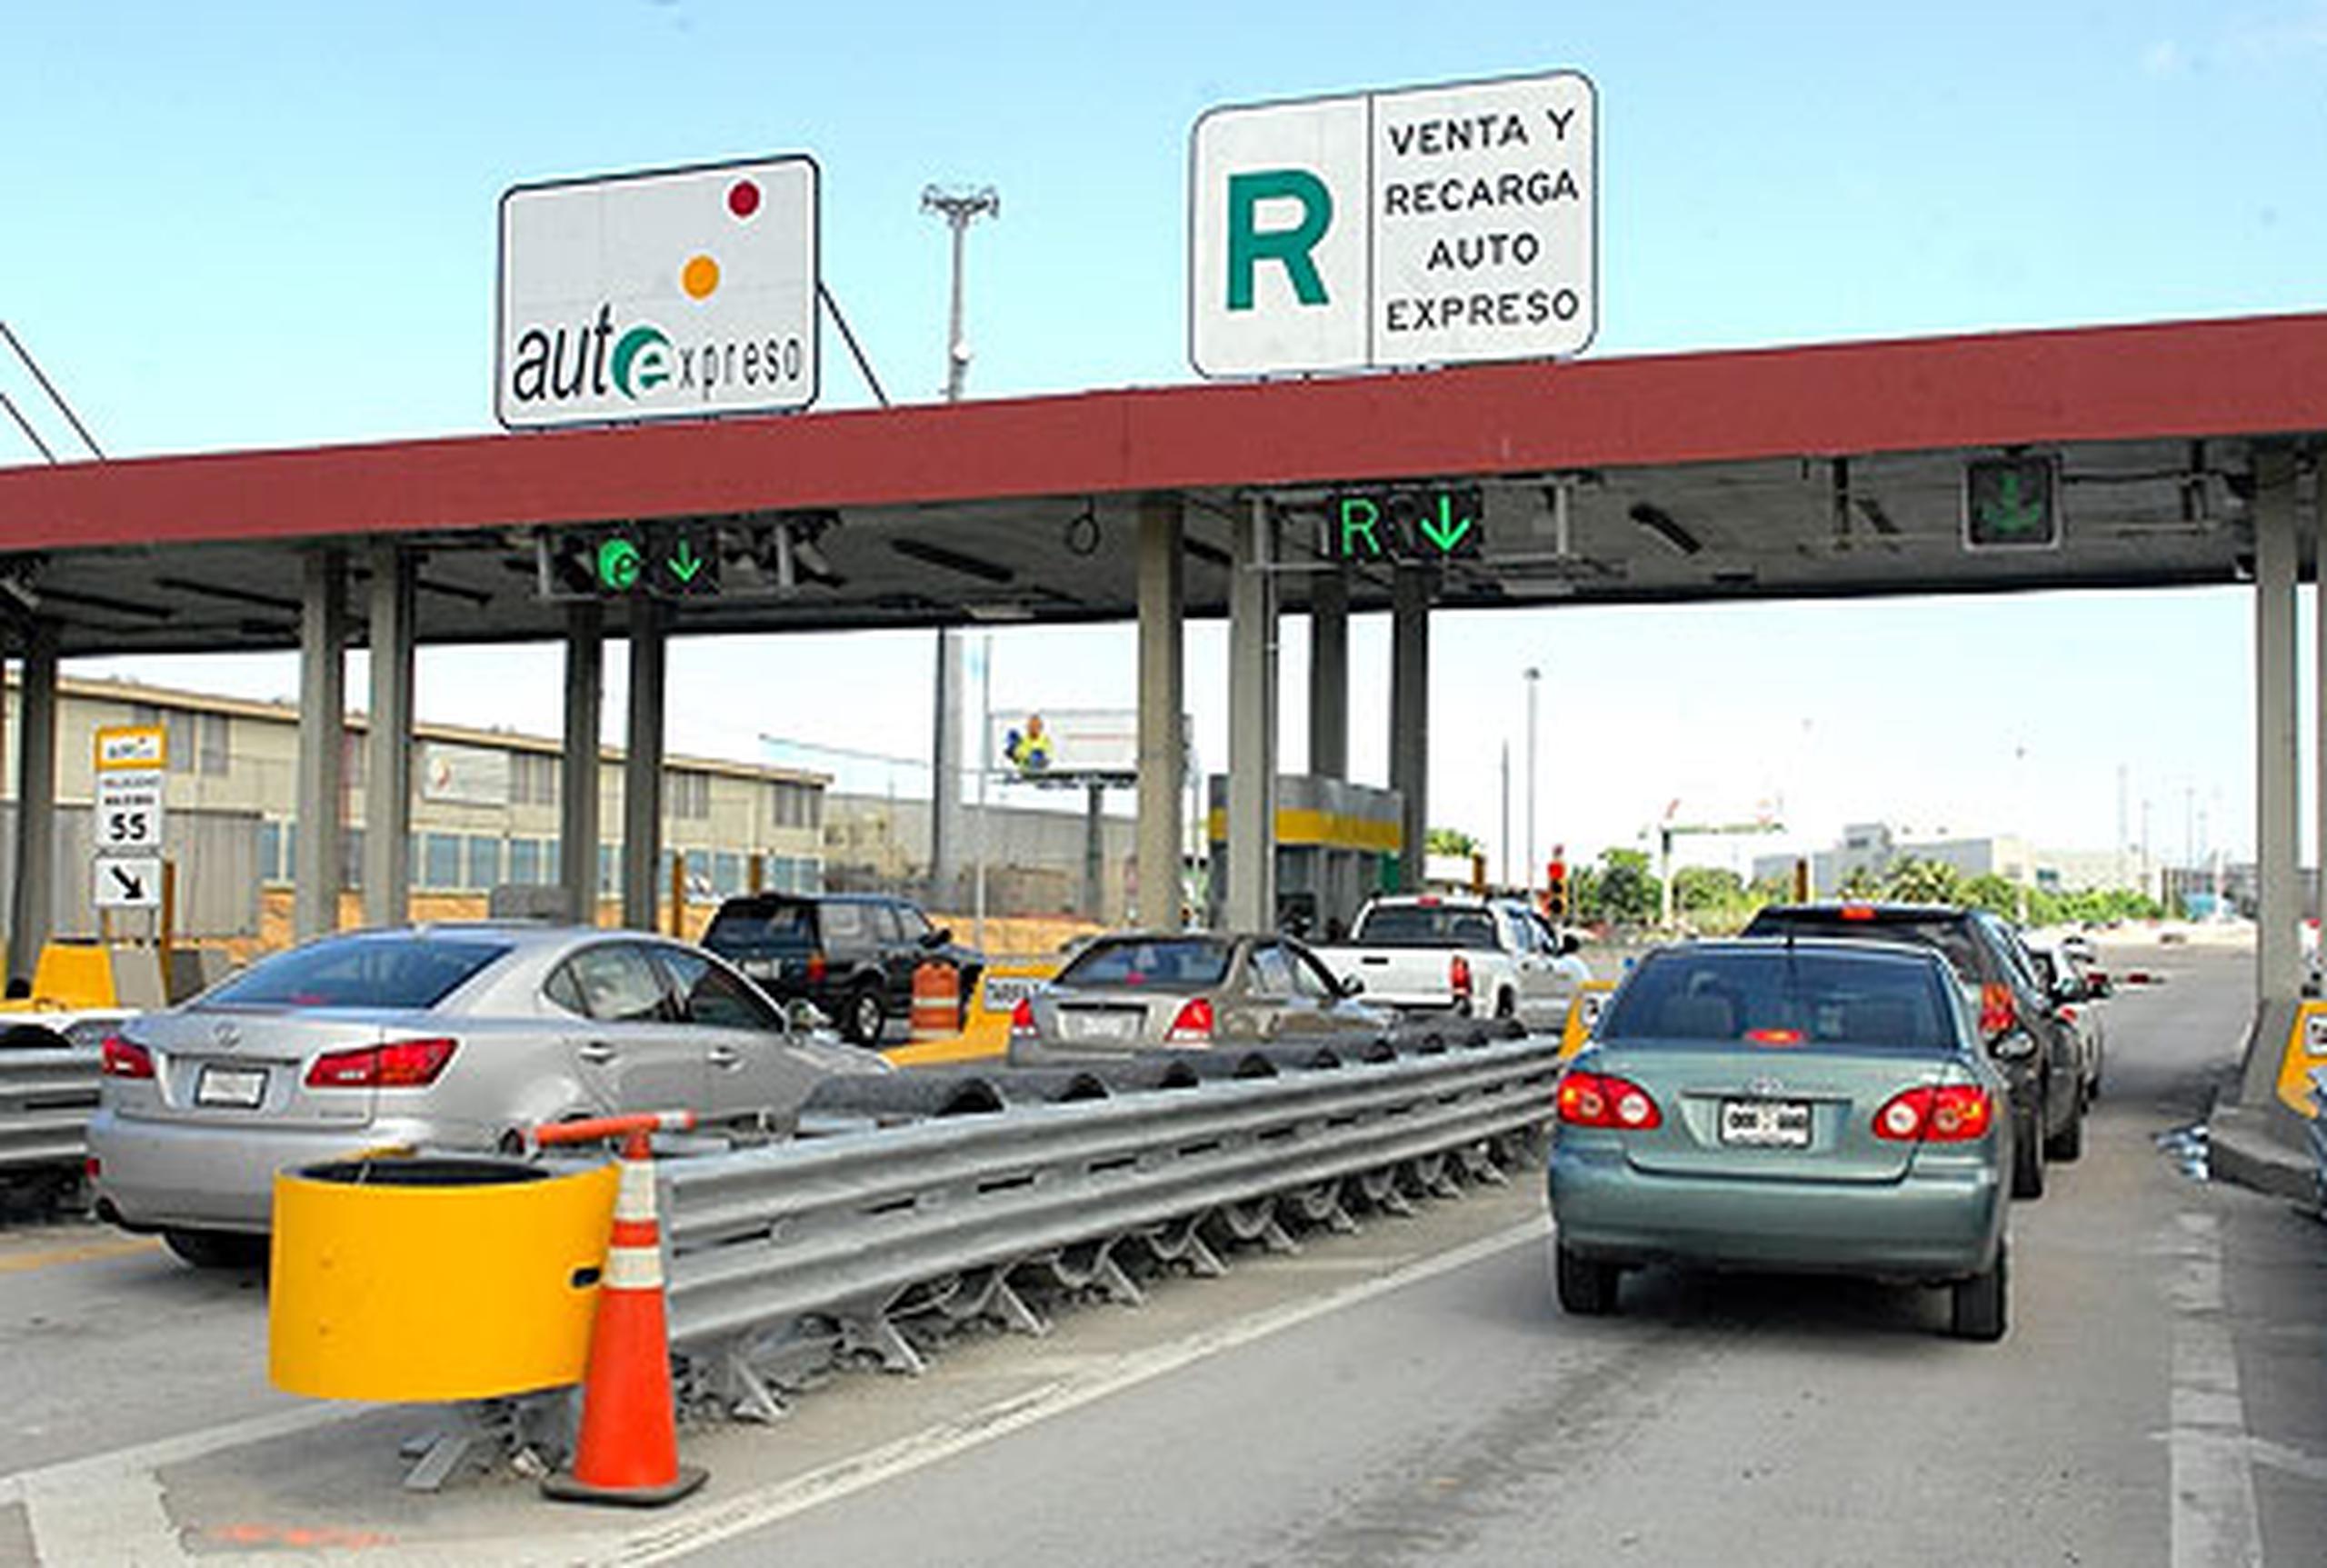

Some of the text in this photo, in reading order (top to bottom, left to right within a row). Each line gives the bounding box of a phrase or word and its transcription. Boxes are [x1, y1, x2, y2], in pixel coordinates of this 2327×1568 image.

[1389, 108, 1574, 155] VENTA Y
[1384, 170, 1579, 215] RECARGA
[1226, 169, 1333, 310] R
[1425, 233, 1539, 271] AUTO
[1385, 288, 1579, 332] EXPRESO
[1341, 498, 1380, 557] R
[110, 813, 147, 841] 55
